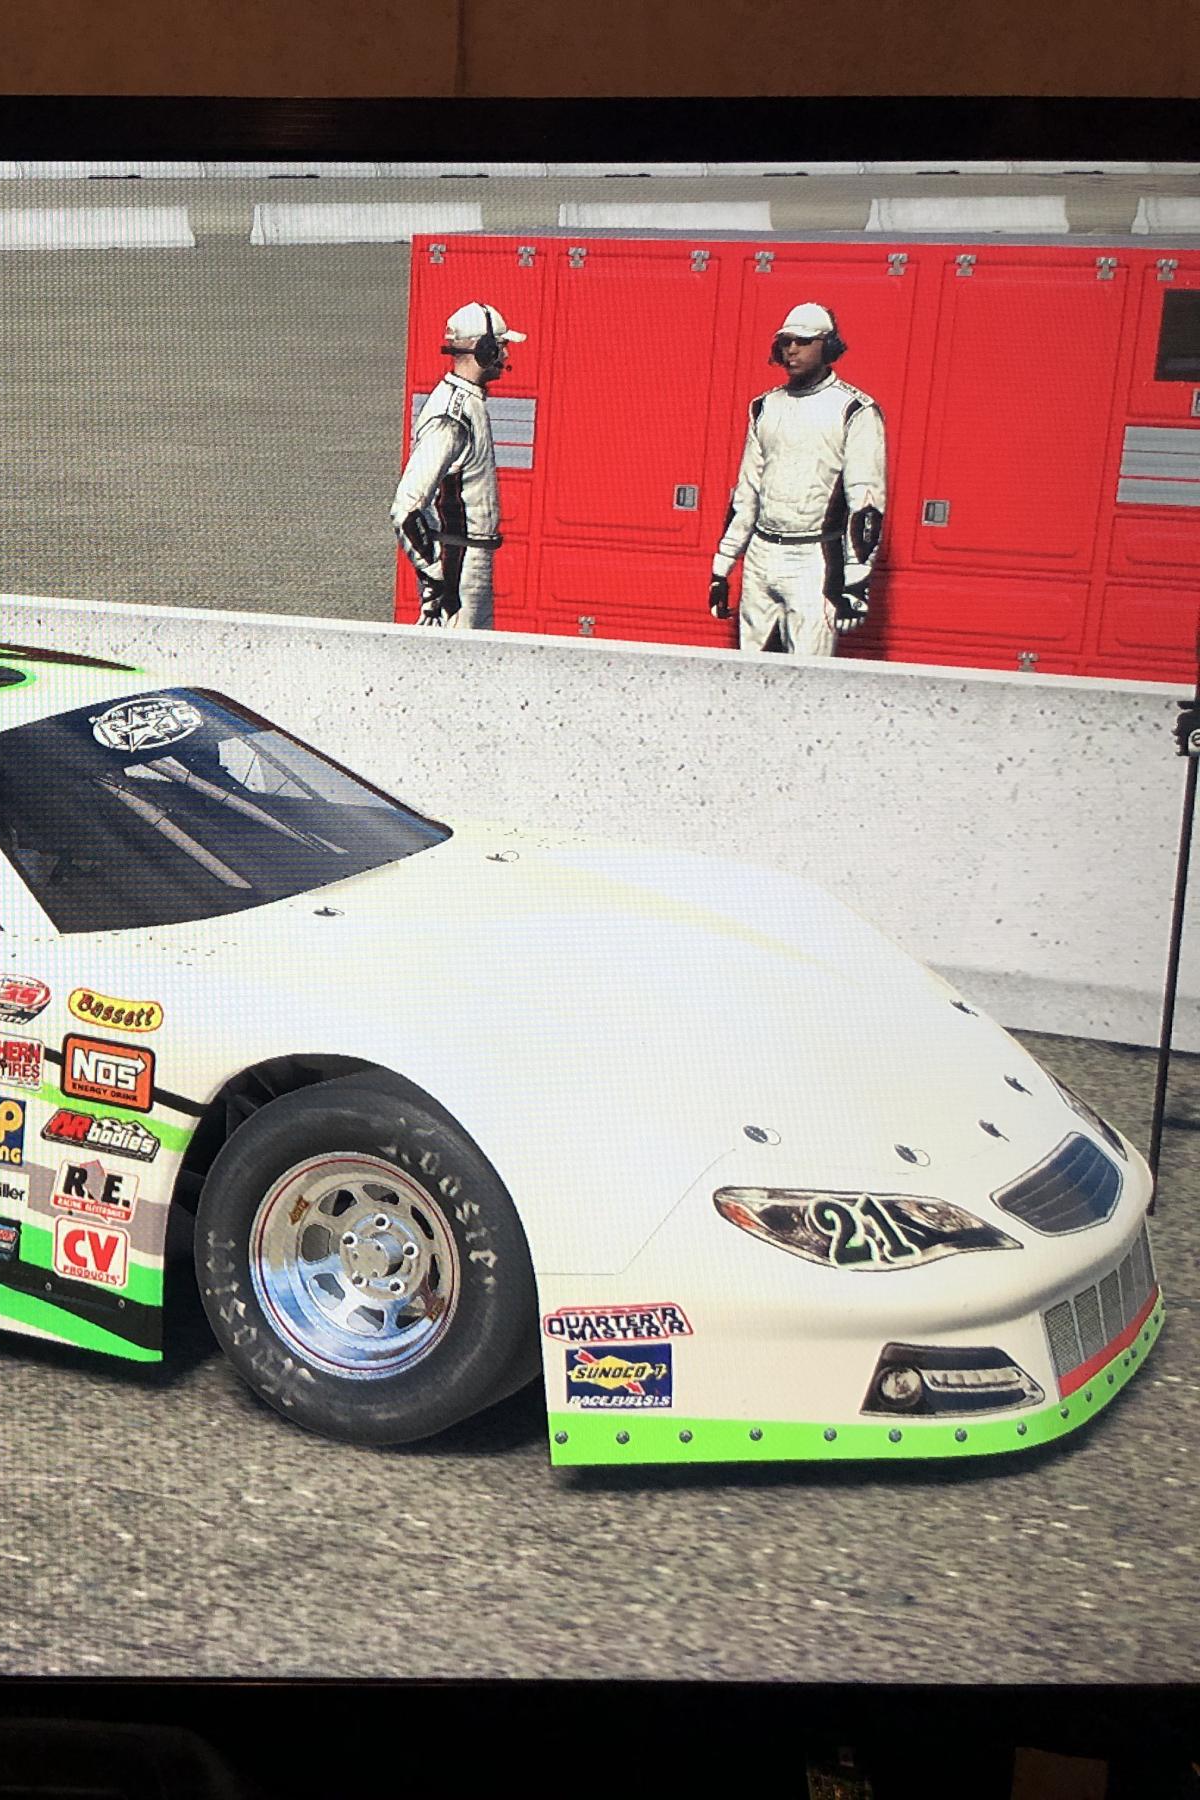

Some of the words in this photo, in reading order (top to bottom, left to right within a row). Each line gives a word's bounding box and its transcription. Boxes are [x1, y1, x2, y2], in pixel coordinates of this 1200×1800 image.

[77, 993, 155, 1026] Bassett
[72, 1047, 146, 1091] NOS
[72, 1082, 108, 1095] ENERGY
[86, 1122, 156, 1155] bodies
[811, 1199, 919, 1266] 21
[63, 1229, 120, 1273] CV
[63, 1265, 120, 1285] PRODUCTS
[548, 1311, 657, 1335] QUARTER
[568, 1325, 661, 1341] MASTER
[575, 1365, 647, 1380] SUNOCO
